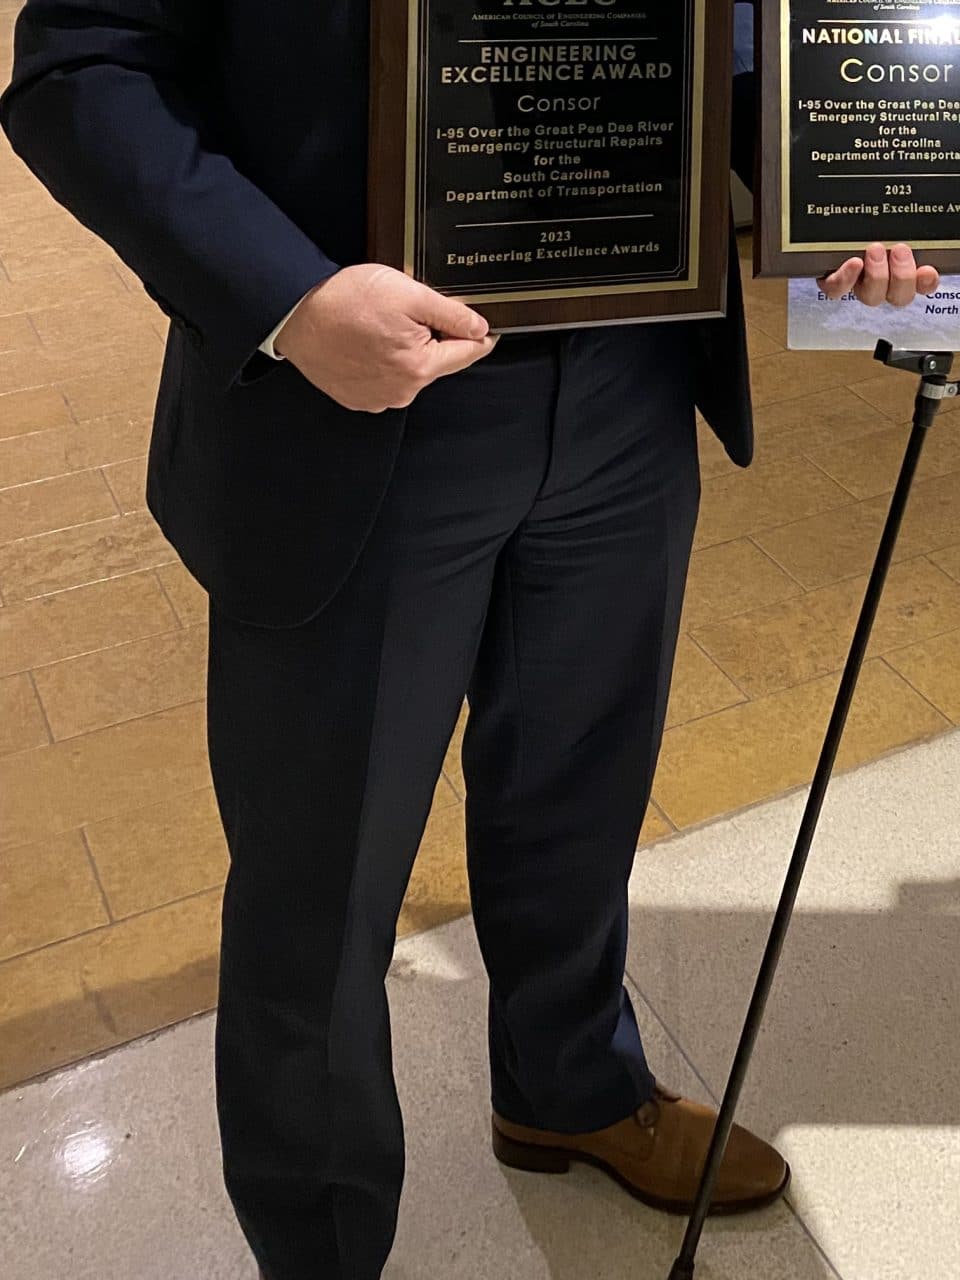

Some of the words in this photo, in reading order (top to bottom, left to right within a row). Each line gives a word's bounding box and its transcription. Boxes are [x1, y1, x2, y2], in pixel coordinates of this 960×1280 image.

[802, 27, 903, 44] NATIONAL
[481, 43, 636, 63] ENGINEERING
[441, 63, 583, 83] EXCELLENCE
[591, 62, 671, 80] AWARD
[840, 58, 954, 82] Consor
[517, 94, 600, 112] Consor
[798, 100, 821, 109] I-95
[824, 99, 853, 109] Over
[855, 99, 874, 109] the
[877, 100, 910, 109] Great
[913, 99, 935, 109] Pee
[938, 100, 960, 109] Dee
[809, 112, 876, 123] Emergency
[879, 111, 939, 121] Structural
[436, 127, 464, 139] I-95
[468, 125, 504, 138] Over
[507, 125, 530, 137] the
[534, 123, 574, 136] Great
[577, 122, 603, 134] Pee
[607, 121, 633, 133] Dee
[637, 120, 674, 132] River
[878, 125, 896, 135] for
[898, 125, 916, 135] the
[447, 139, 530, 155] Emergency
[533, 136, 605, 150] Structural
[609, 134, 663, 149] Repairs
[854, 138, 888, 148] South
[891, 137, 941, 147] Carolina
[533, 154, 554, 166] for
[558, 153, 581, 164] the
[811, 150, 880, 162] Department
[882, 150, 895, 160] of
[502, 170, 545, 183] South
[549, 167, 610, 181] Carolina
[446, 187, 533, 204] Department
[537, 185, 552, 197] of
[556, 180, 662, 198] Transportation
[885, 184, 911, 195] 2023
[806, 203, 879, 216] Engineering
[882, 202, 943, 213] Excellence
[539, 230, 571, 242] 2023
[446, 248, 532, 267] Engineering
[535, 244, 607, 259] Excellence
[610, 240, 659, 255] Awards
[925, 304, 958, 314] North
